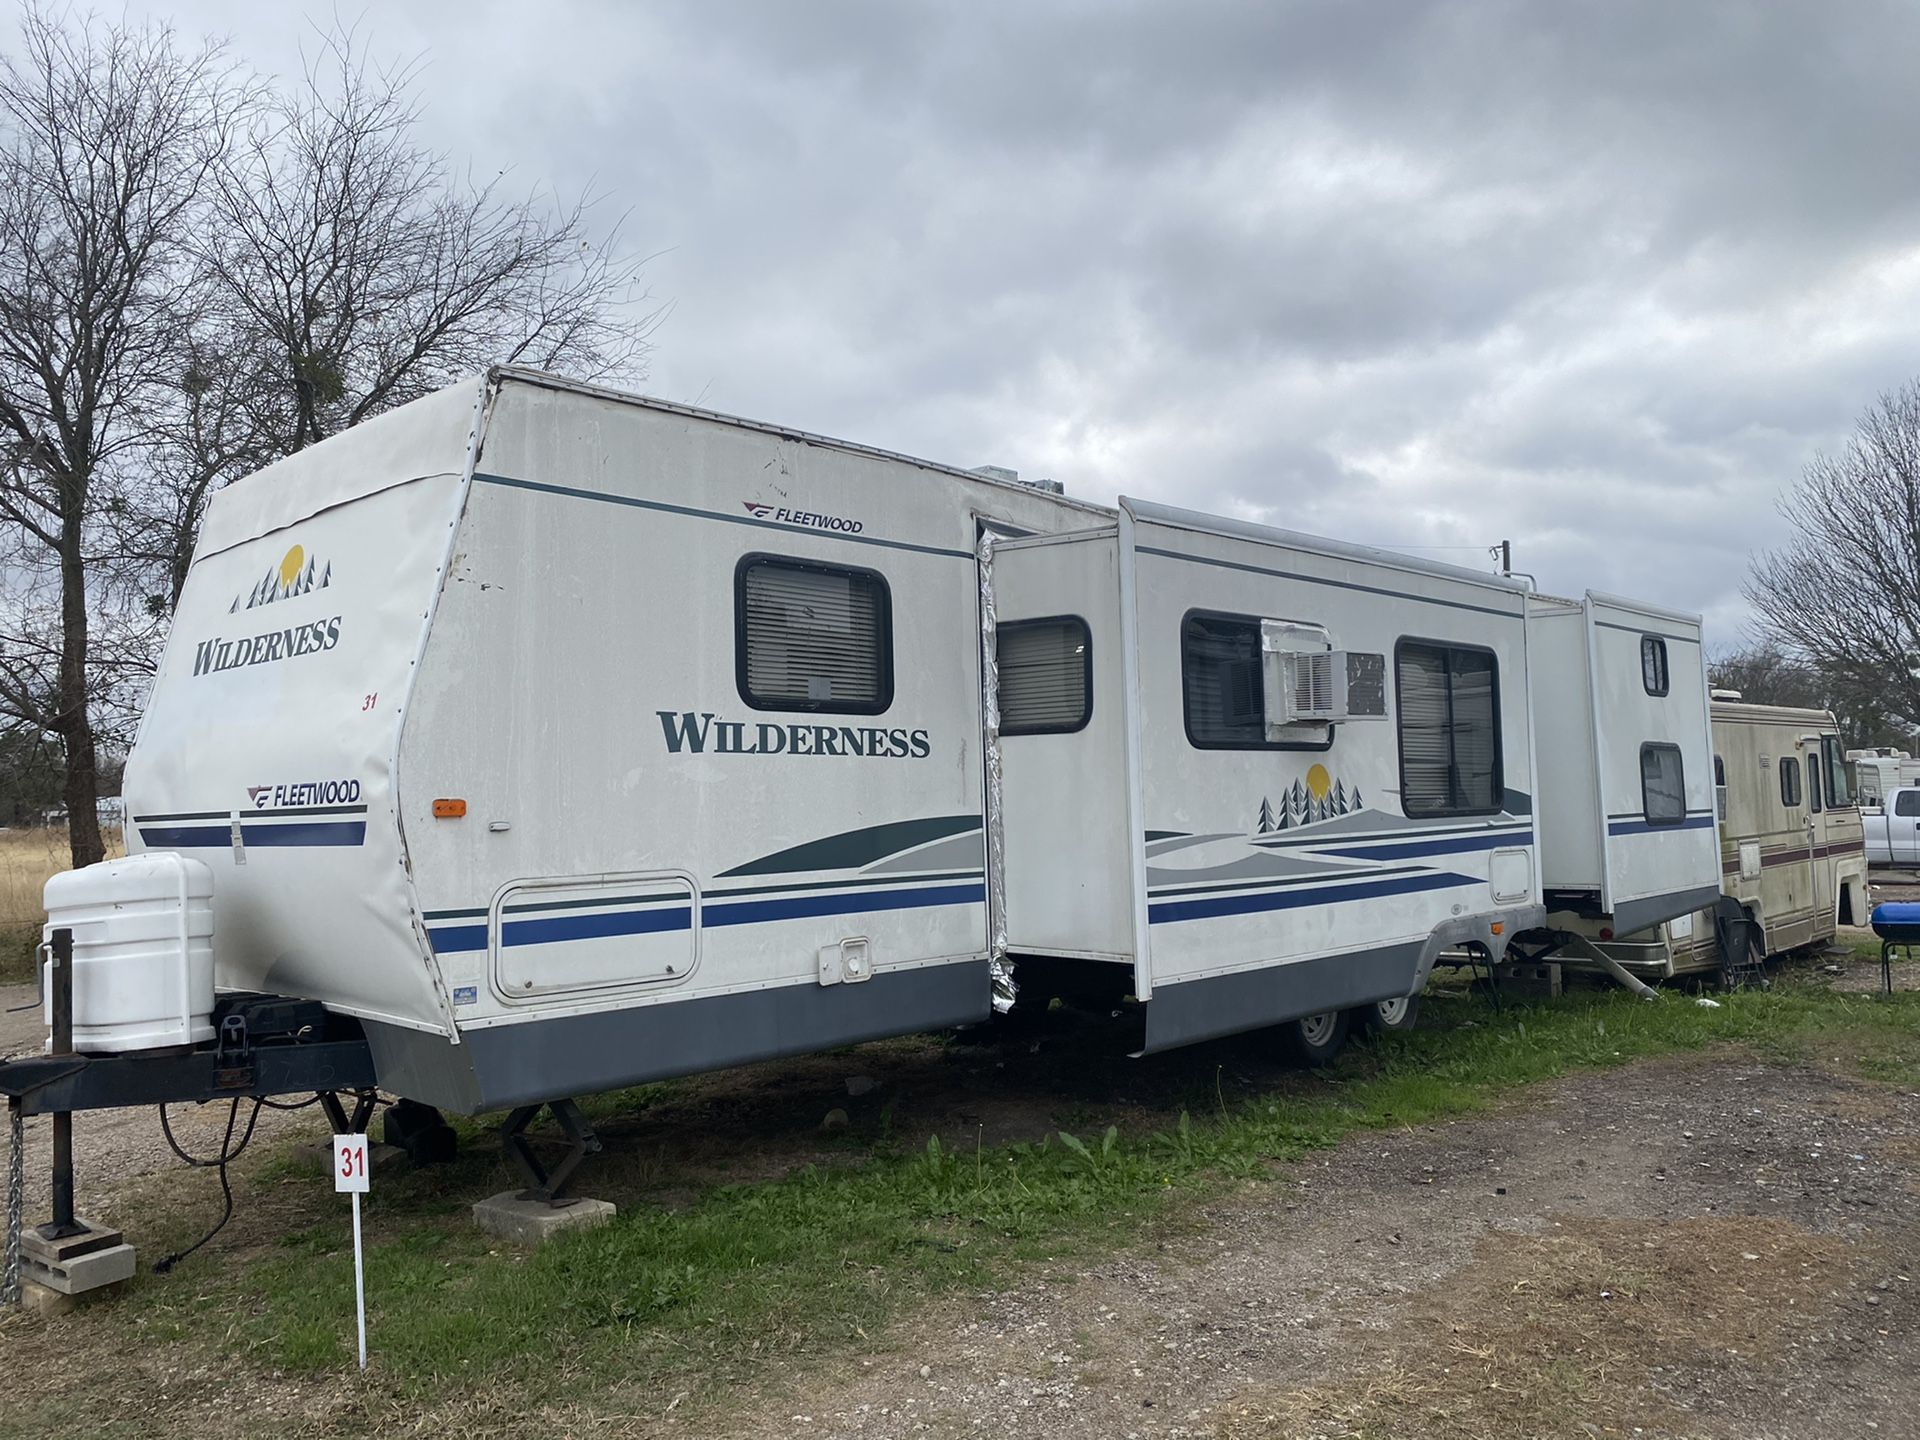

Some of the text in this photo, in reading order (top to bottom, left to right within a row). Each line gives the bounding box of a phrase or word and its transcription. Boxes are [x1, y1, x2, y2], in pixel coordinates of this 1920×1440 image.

[775, 507, 863, 533] FLEETWOOD
[193, 616, 342, 677] WILDERNESS
[362, 692, 378, 711] 31
[656, 711, 931, 758] WILDERNESS
[274, 779, 360, 807] FLEETWOOD
[341, 1147, 363, 1177] 31
